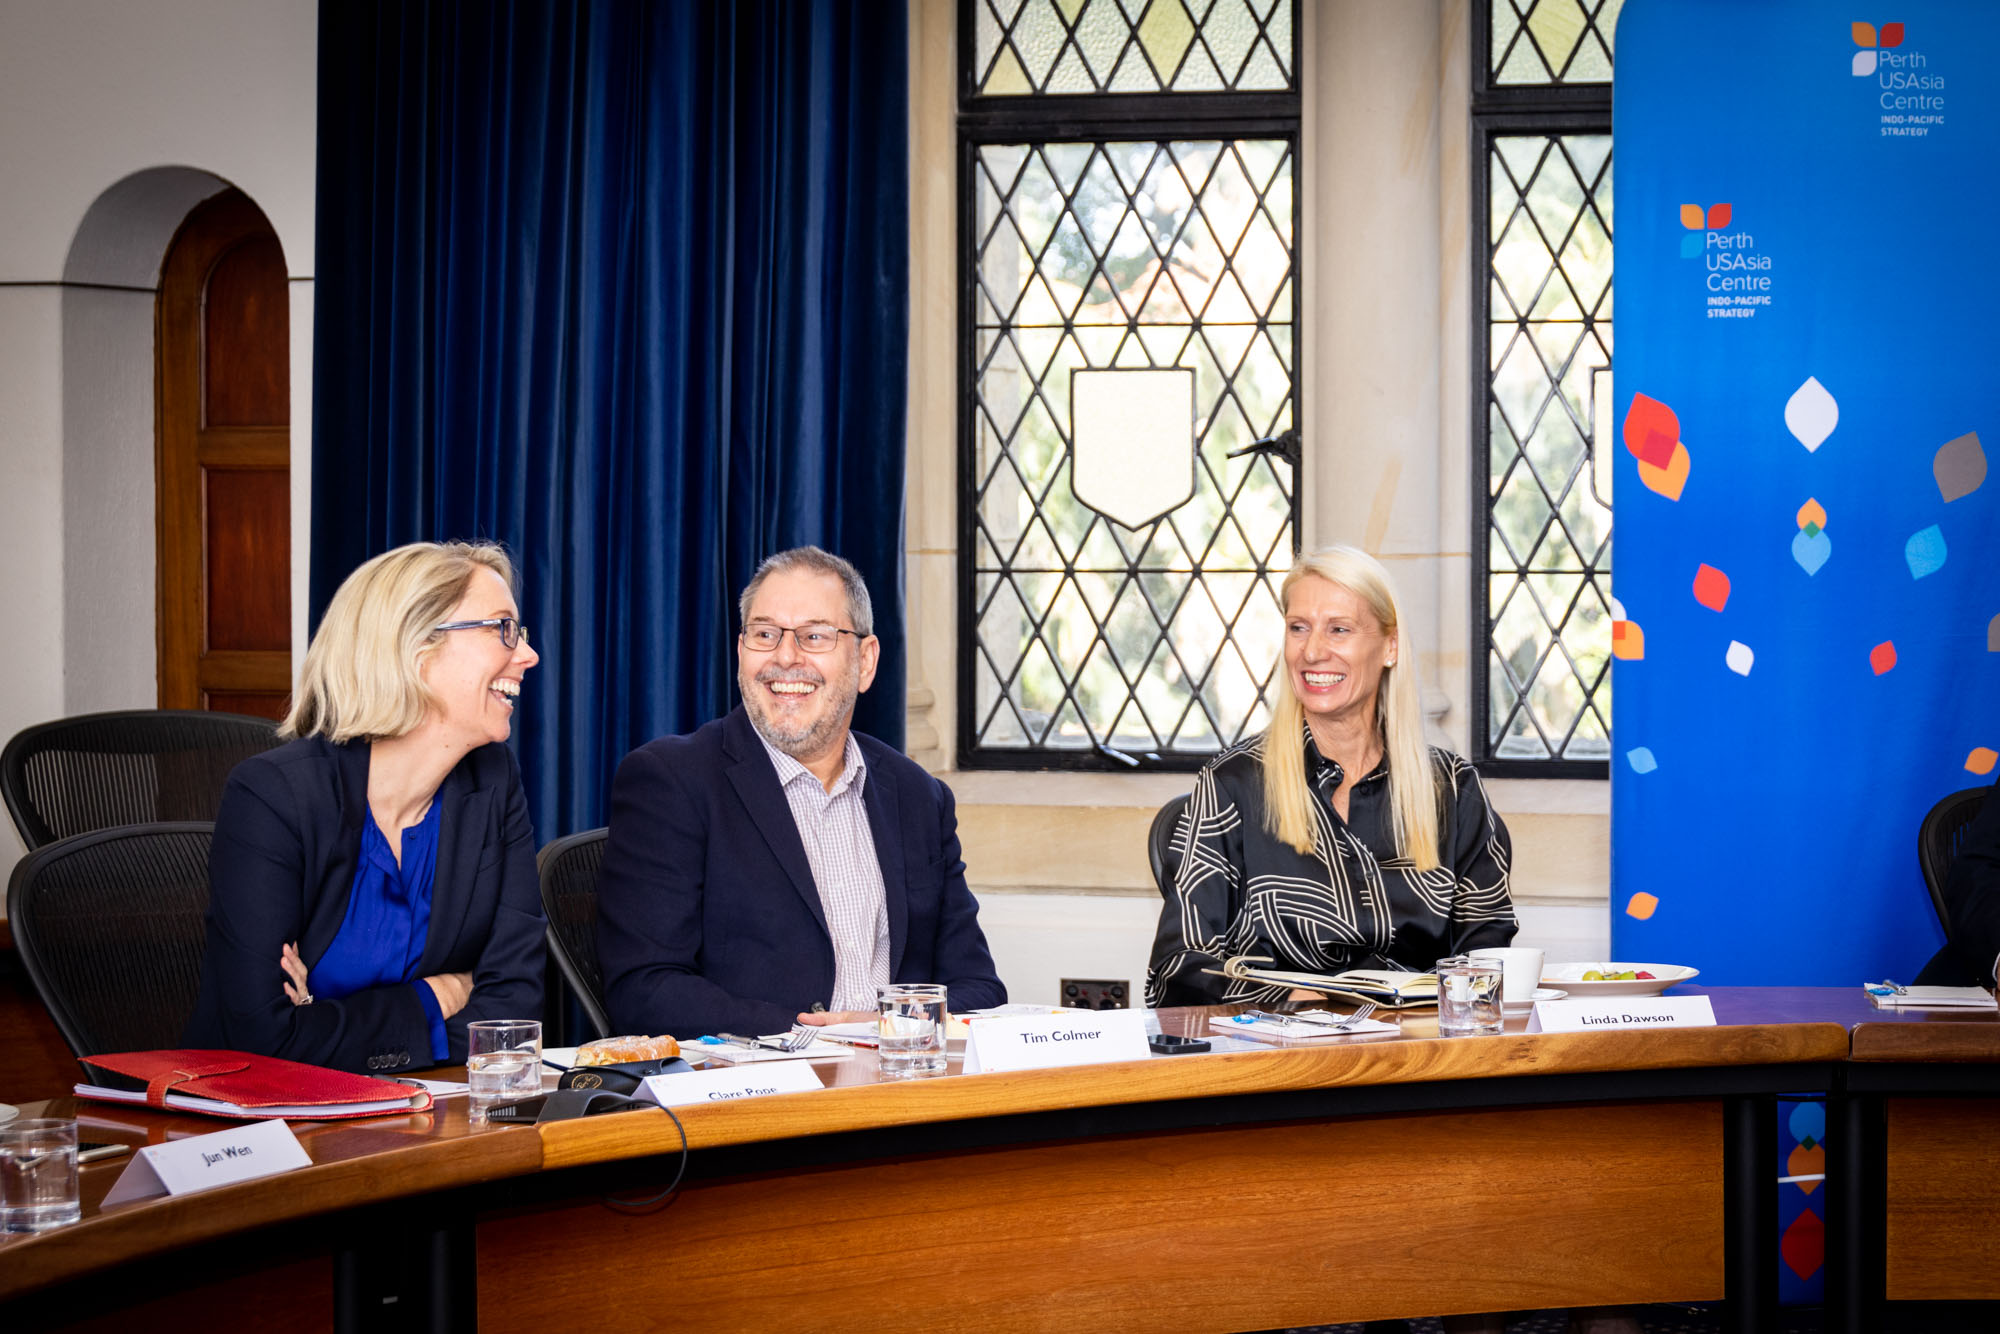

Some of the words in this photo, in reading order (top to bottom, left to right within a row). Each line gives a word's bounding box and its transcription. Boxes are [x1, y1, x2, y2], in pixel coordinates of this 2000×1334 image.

[1879, 50, 1926, 68] Perth
[1879, 72, 1945, 90] USAsia
[1879, 92, 1945, 110] Centre
[1881, 115, 1945, 125] INDO-PACIFIC
[1881, 127, 1929, 137] STRATEGY
[1706, 231, 1753, 249] Perth
[1706, 252, 1772, 271] USAsia
[1706, 273, 1772, 292] Centre
[1707, 295, 1772, 306] INDO-PACIFIC
[1707, 308, 1756, 318] STRATEGY
[1581, 1015, 1618, 1025] Linda
[1621, 1014, 1674, 1024] Dawson
[1020, 1032, 1048, 1044] Tim
[1052, 1030, 1101, 1042] Colmer
[202, 1152, 224, 1167] Jun
[222, 1145, 253, 1158] Wen
